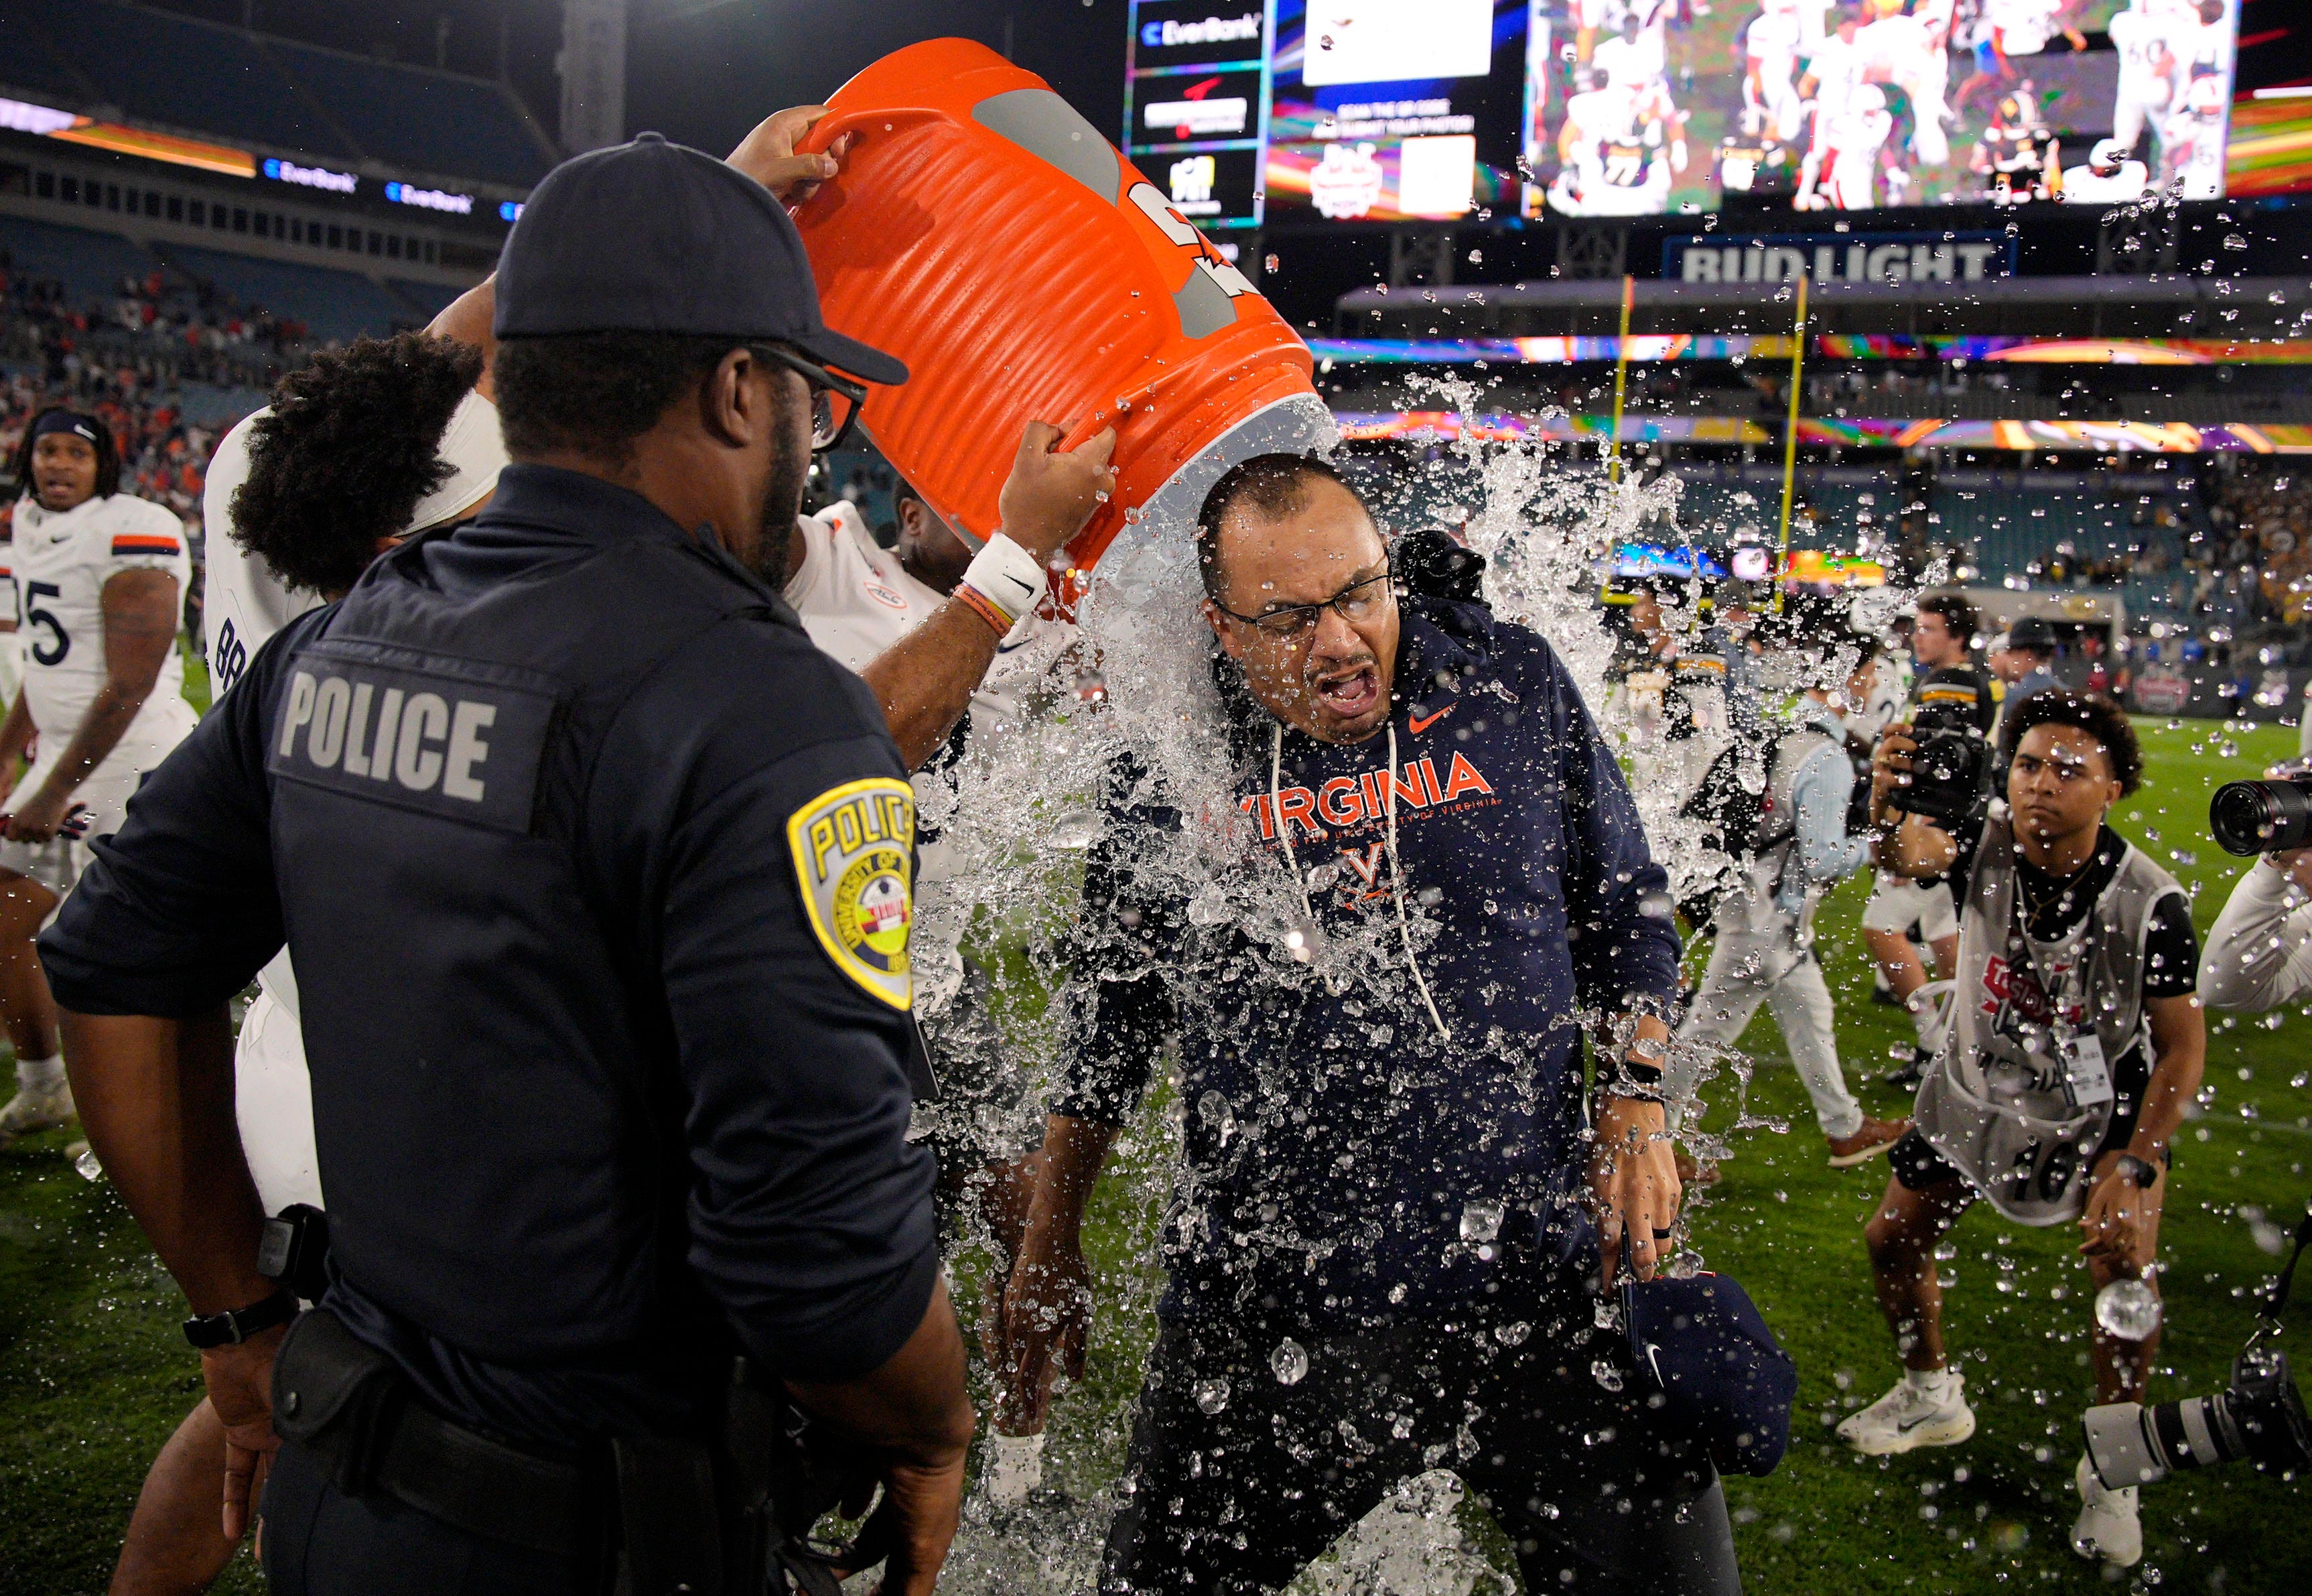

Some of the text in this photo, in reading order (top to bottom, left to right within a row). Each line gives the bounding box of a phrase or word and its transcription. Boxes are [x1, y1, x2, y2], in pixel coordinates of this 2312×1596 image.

[1162, 13, 1260, 46] EverBank
[1682, 244, 1994, 283] BUD LIGHT
[279, 671, 497, 803] POLICE
[1420, 809, 1435, 821] OF
[1441, 797, 1497, 815] VIRGINIA
